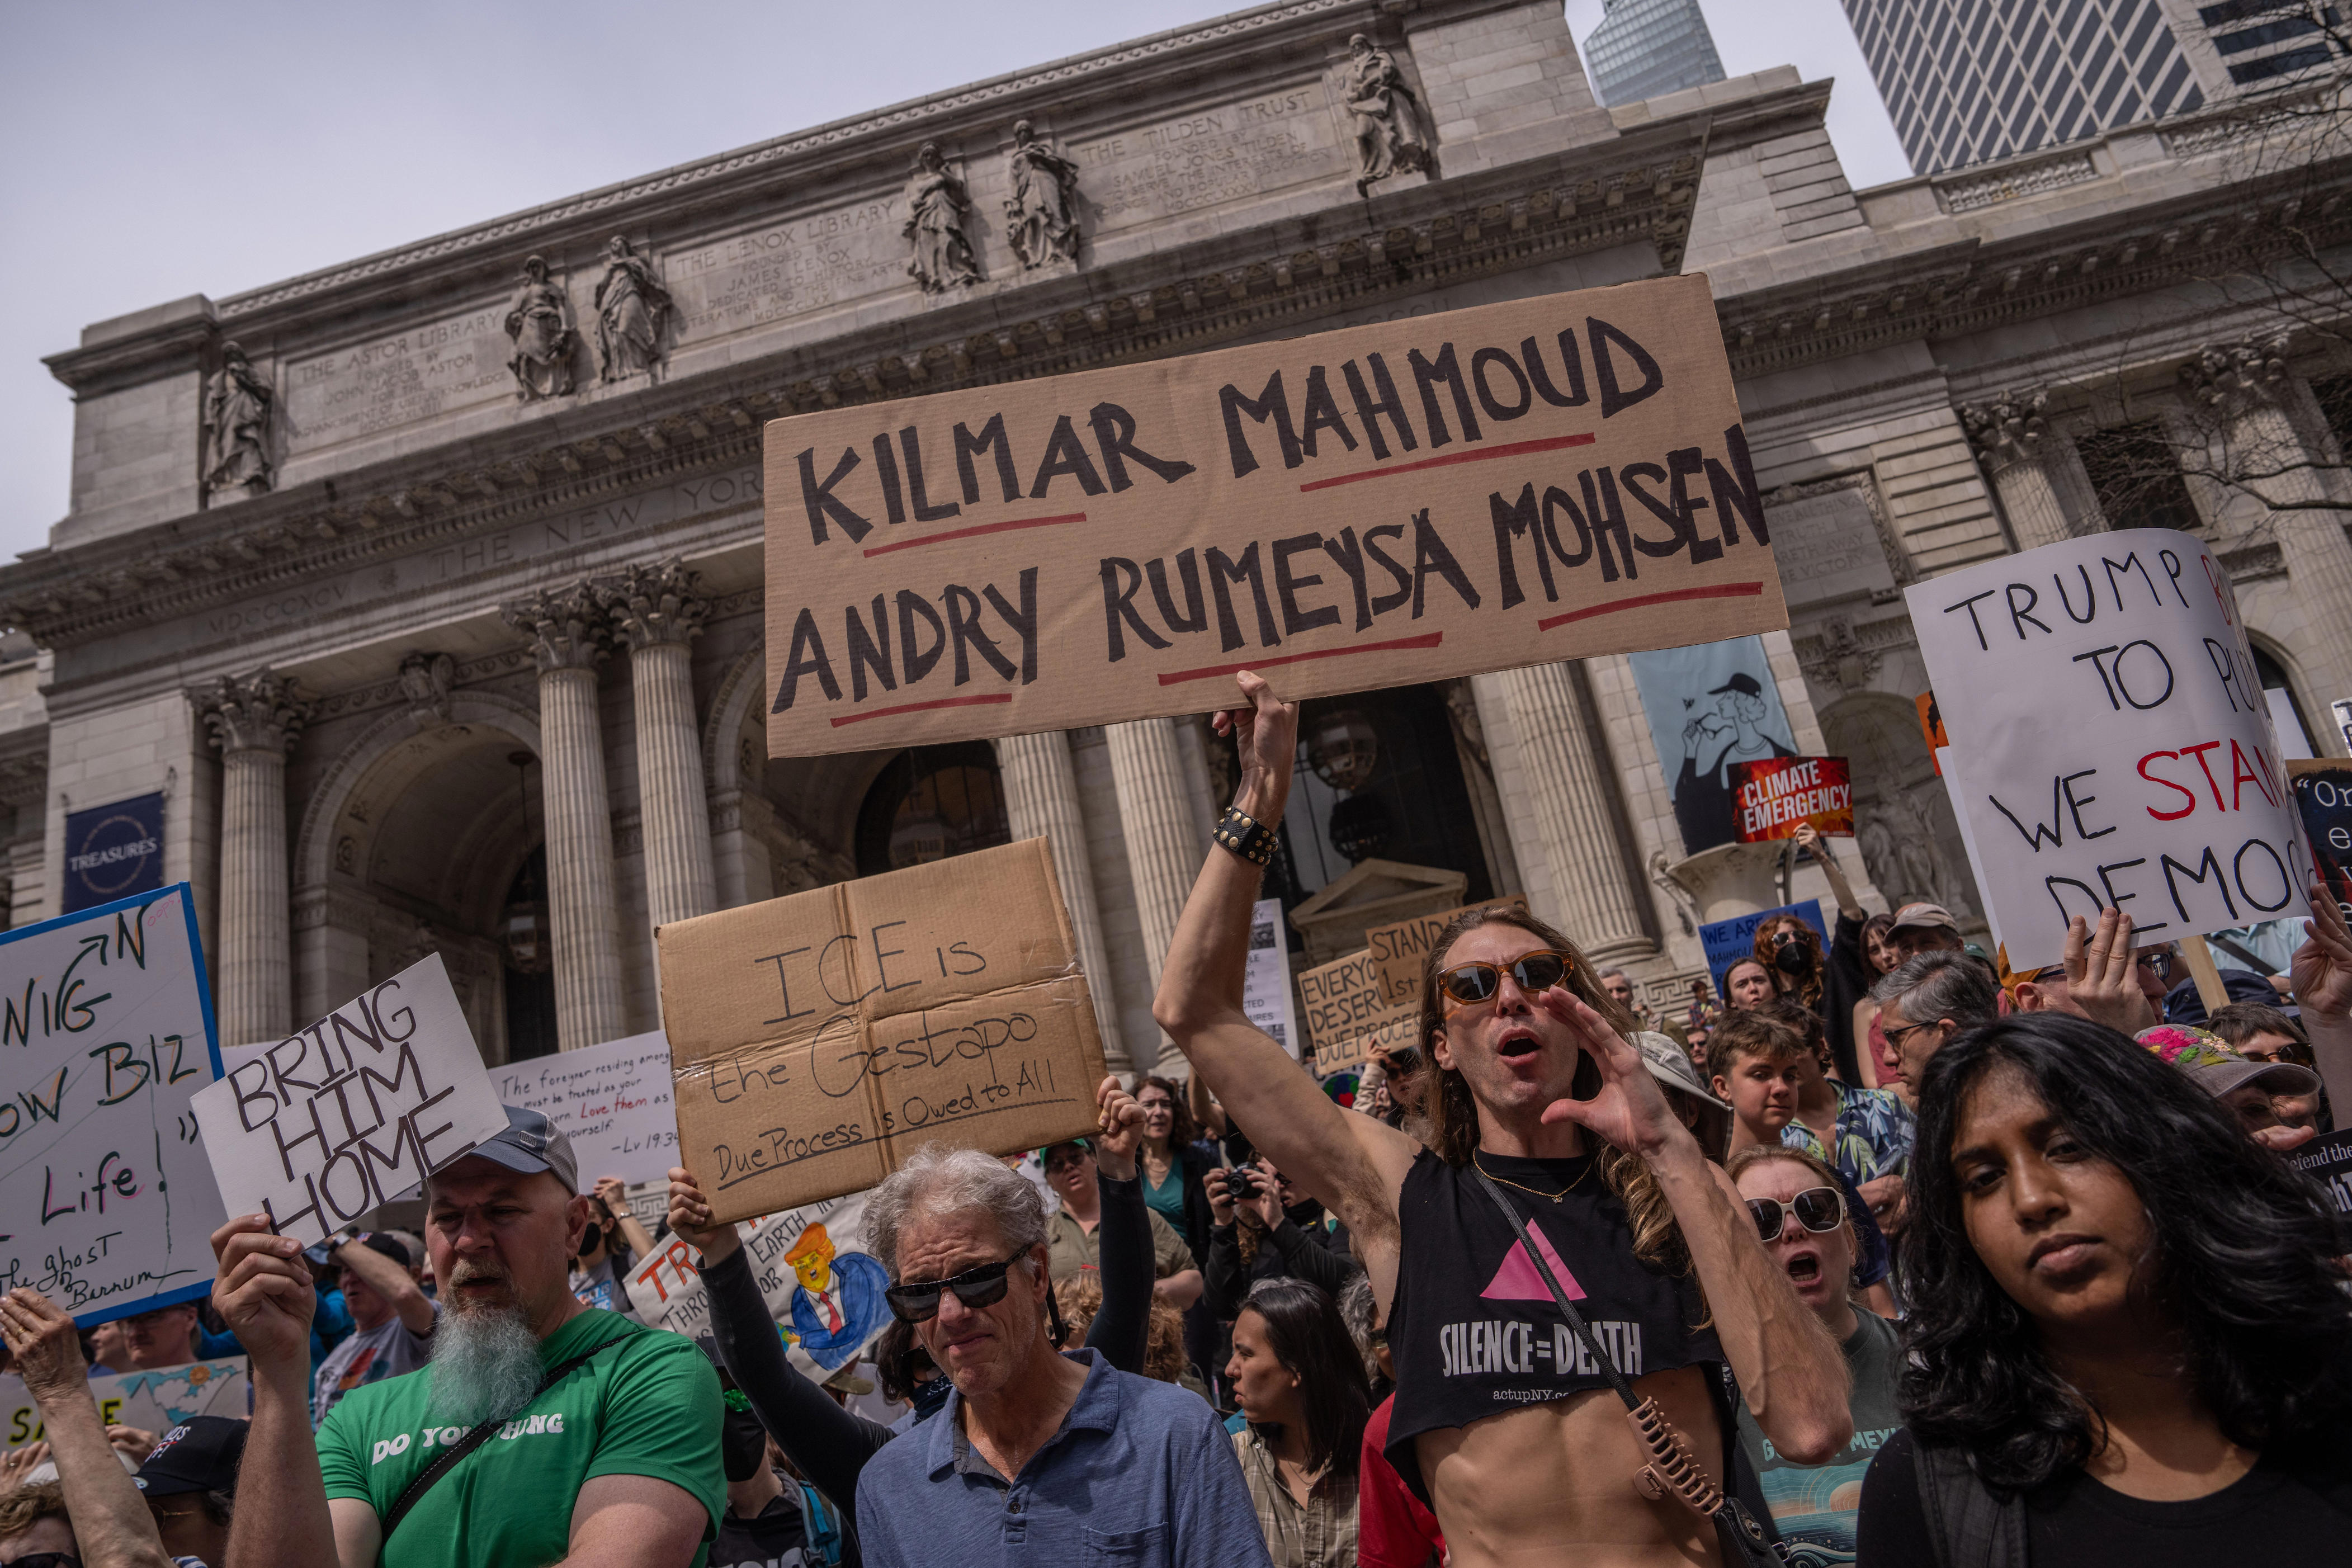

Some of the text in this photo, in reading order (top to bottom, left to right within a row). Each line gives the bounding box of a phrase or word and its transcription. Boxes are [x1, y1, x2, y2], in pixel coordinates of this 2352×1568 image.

[1081, 91, 1310, 166] THE TILDEN TRUST
[1154, 131, 1247, 163] FOUNDED BY
[1113, 130, 1298, 188] SAMUEL JONES TILDEN
[1131, 177, 1169, 196] SERVE
[1178, 169, 1206, 184] THE
[1291, 142, 1307, 155] OF
[677, 201, 894, 275] THE LENOX LIBRARY
[743, 242, 831, 273] FOUNDED BY
[707, 282, 778, 310] DEDICATED
[786, 275, 804, 289] TO
[728, 248, 849, 292] JAMES LENOX
[803, 281, 829, 297] THE
[871, 261, 904, 278] ARTS
[299, 311, 500, 382] THE ASTOR LIBRARY
[324, 353, 474, 407] JOHN JACOB ASTOR
[793, 317, 1664, 546] KILMAR MAHMOUD
[431, 534, 514, 579] THE
[545, 498, 644, 549] NEW
[683, 469, 764, 510] YOR
[771, 423, 1770, 714] ANDRY RUMEYSA MOHSEN
[1943, 549, 2190, 651] TRUMP
[2072, 639, 2174, 711] TO
[1744, 759, 1822, 808] CLIMATE
[1744, 783, 1850, 834] EMERGENCY
[1989, 739, 2286, 853] WE STAN
[69, 837, 157, 872] TREASURES
[2045, 839, 2314, 947] DEMOC
[1372, 920, 1444, 962] STAND
[1703, 925, 1730, 945] WE
[1707, 945, 1752, 965] MAHMOU
[754, 920, 986, 1025] ICE is
[1301, 957, 1377, 1005] EVERYO
[1382, 967, 1420, 1000] 1st
[227, 979, 417, 1133] BRING
[710, 1009, 1037, 1104] the Gestapo
[1315, 1010, 1422, 1067] DUE PROCES
[502, 1052, 669, 1098] The foreigner residing among
[523, 1096, 549, 1109] must
[553, 1092, 563, 1104] be
[568, 1081, 601, 1100] treated
[604, 1084, 616, 1093] as
[616, 1078, 642, 1096] your
[271, 1042, 429, 1183] HIM
[580, 1102, 610, 1119] Love
[614, 1095, 648, 1113] them
[654, 1093, 669, 1104] as
[714, 1059, 1056, 1181] Due Process is Owed to All
[261, 1085, 477, 1238] HOME
[2282, 1146, 2331, 1170] efend
[749, 1210, 807, 1264] EARTH
[659, 1289, 709, 1335] THRO
[372, 1413, 564, 1466] DO YO HING
